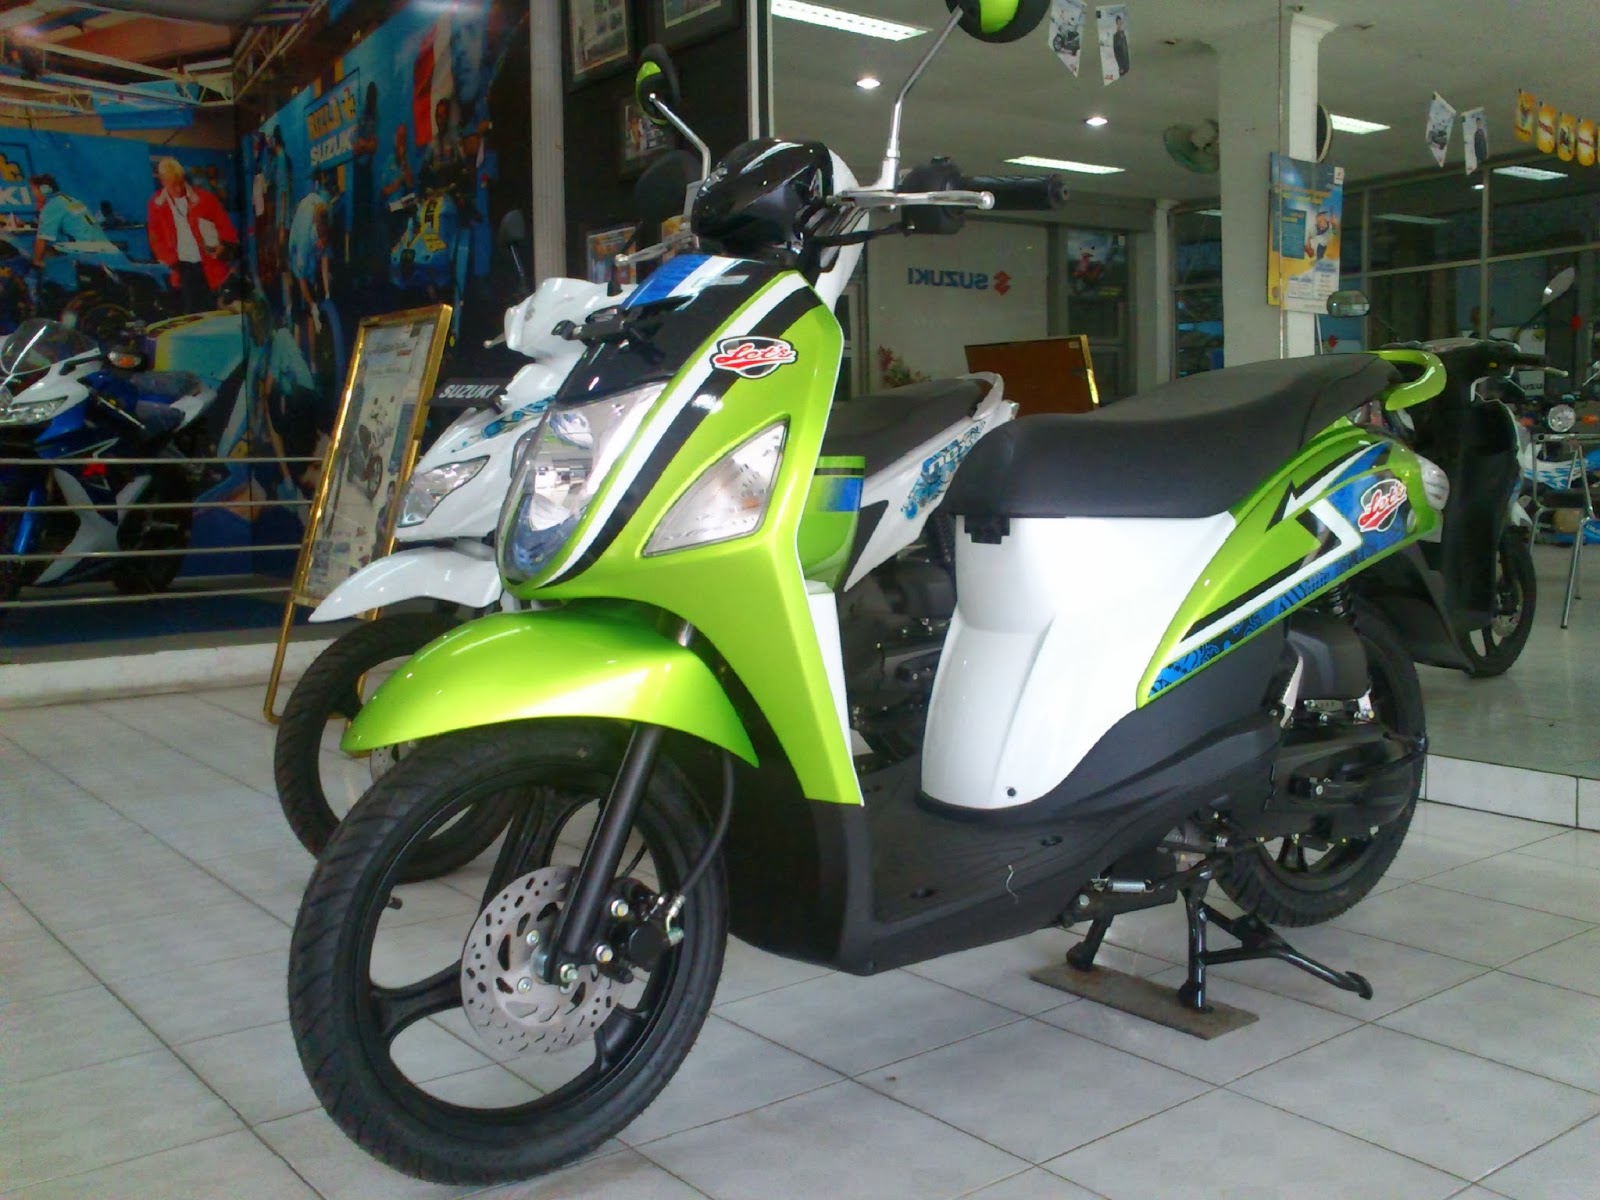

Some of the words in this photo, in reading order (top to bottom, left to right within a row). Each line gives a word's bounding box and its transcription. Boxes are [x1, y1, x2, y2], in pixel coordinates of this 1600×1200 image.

[713, 343, 795, 366] Let's
[439, 384, 500, 399] SUZUKI
[1359, 482, 1407, 528] Let's
